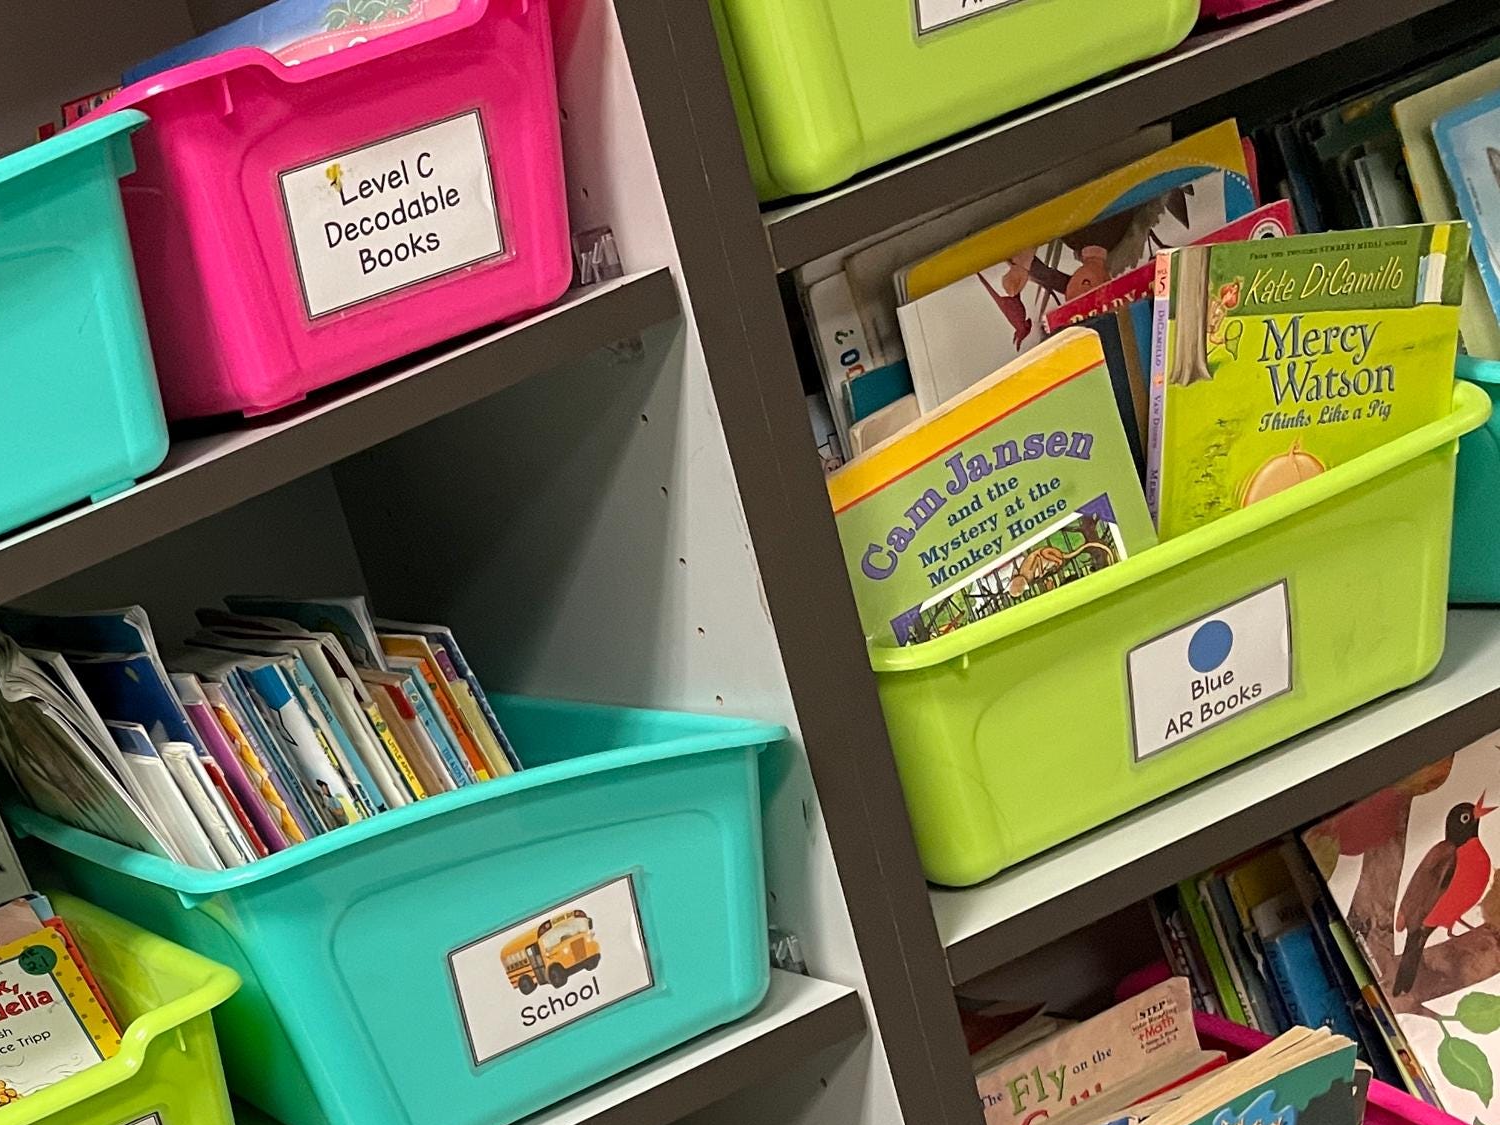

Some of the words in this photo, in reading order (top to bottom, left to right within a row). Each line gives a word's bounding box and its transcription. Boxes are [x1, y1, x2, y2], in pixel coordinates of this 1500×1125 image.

[338, 159, 409, 206] Level
[417, 151, 434, 178] C
[324, 186, 461, 249] Decodable
[360, 233, 441, 275] Books
[1245, 268, 1296, 306] Kate
[1300, 256, 1404, 300] DiCamillo
[1257, 315, 1382, 366] Mercy
[1265, 360, 1396, 407] Watson
[1258, 407, 1312, 433] Thinks
[1317, 405, 1350, 427] Like
[1352, 409, 1362, 420] a
[1368, 399, 1392, 422] Pig
[861, 488, 947, 581] Cam
[945, 431, 1095, 495] Jansen
[918, 513, 999, 570] Mystery
[1004, 497, 1025, 519] at
[1029, 475, 1061, 505] the
[948, 495, 984, 527] and
[987, 475, 1020, 505] the
[926, 536, 1004, 589] Monkey
[1008, 496, 1068, 541] House
[1164, 711, 1194, 740] AR
[1200, 682, 1262, 723] Books
[1190, 670, 1235, 701] Blue
[520, 976, 601, 1027] School
[17, 1029, 51, 1051] Tripp
[1005, 1063, 1067, 1116] Fly
[1072, 1060, 1088, 1075] on
[1092, 1047, 1113, 1065] the
